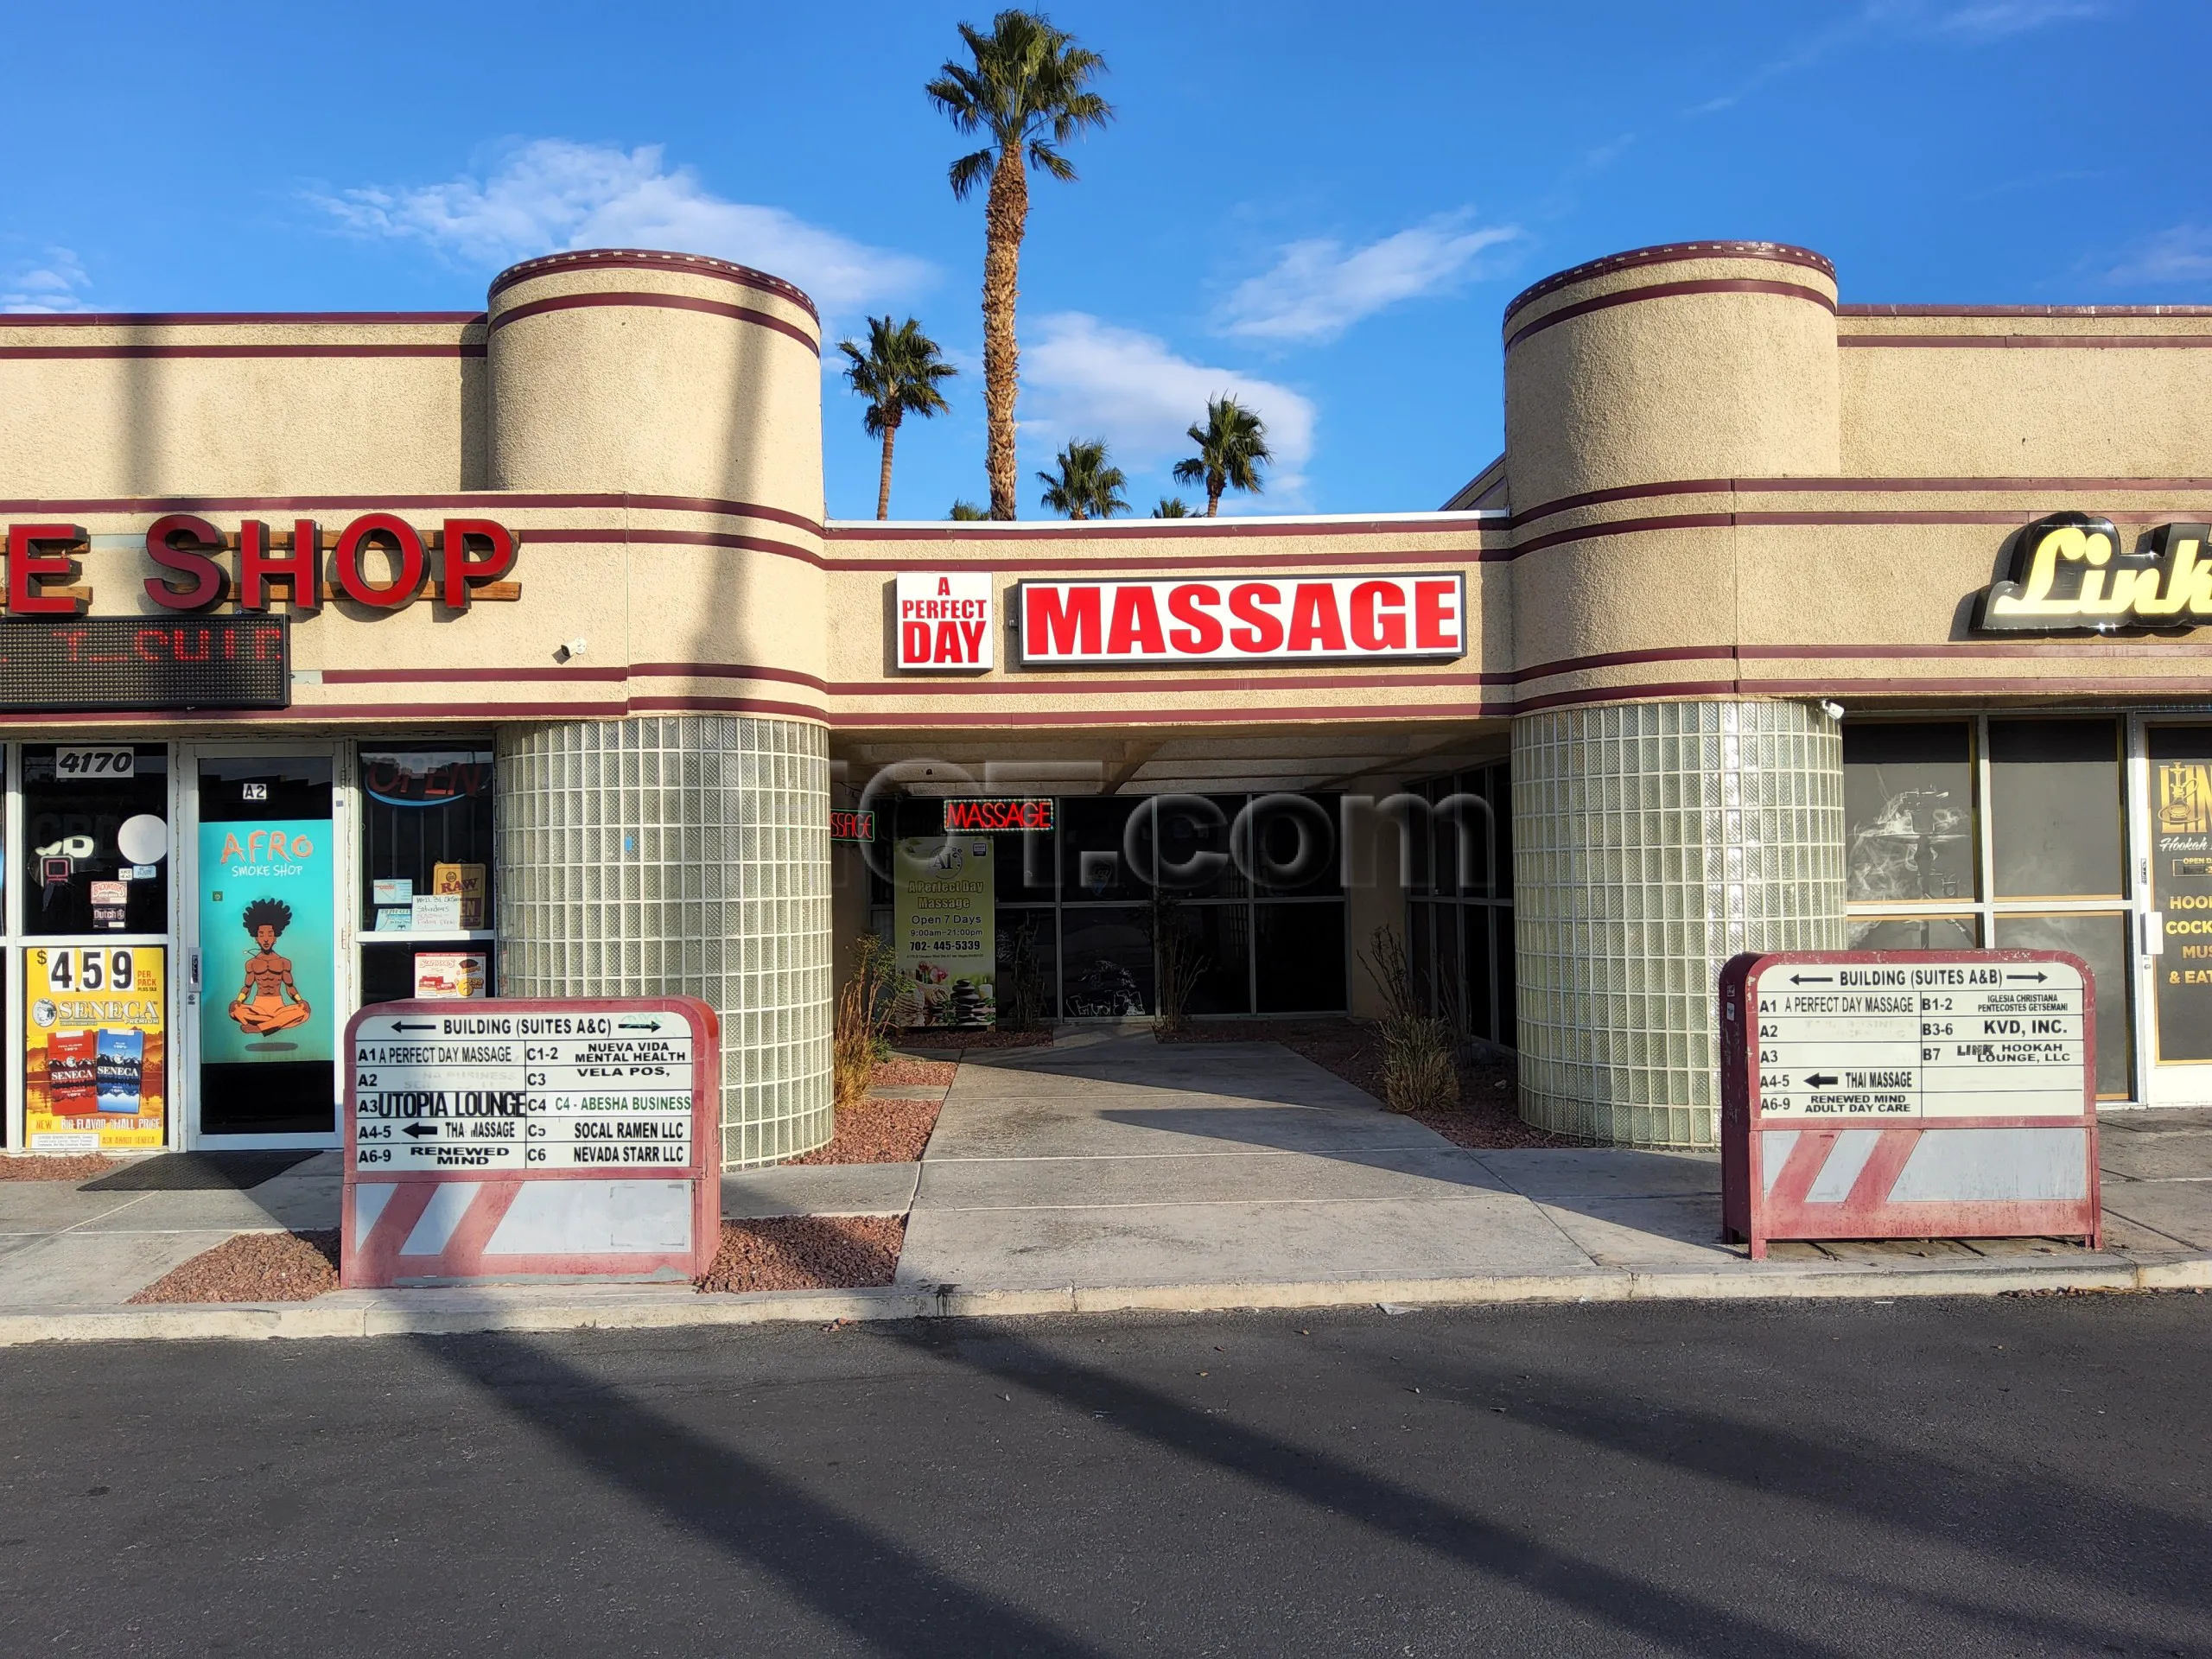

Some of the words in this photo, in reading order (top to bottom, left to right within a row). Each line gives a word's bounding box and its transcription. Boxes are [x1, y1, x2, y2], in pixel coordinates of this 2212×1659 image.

[143, 513, 518, 611] SHOP
[1993, 527, 2212, 614] Link
[936, 576, 950, 597] A
[902, 599, 987, 620] PERFECT
[1025, 580, 1459, 656] MASSAGE
[903, 620, 987, 664] DAY
[59, 752, 133, 773] 4170
[245, 784, 265, 798] A2
[945, 802, 1052, 829] MASSAGE
[830, 812, 873, 839] SSAGE
[221, 830, 315, 865] AFRO
[2159, 836, 2209, 852] Hookah
[231, 865, 270, 877] SMOKE
[273, 863, 303, 876] SHOP
[441, 877, 479, 893] RAW
[908, 881, 917, 893] A
[918, 880, 962, 893] Perfect
[962, 880, 984, 894] Day
[918, 897, 971, 910] Massage
[93, 909, 117, 918] Dutch
[912, 915, 941, 925] Open
[944, 915, 950, 924] 7
[953, 915, 982, 925] Days
[933, 940, 981, 950] 445-5339
[1840, 970, 1906, 986] BUILDING
[1910, 969, 1964, 989] (SUITES
[1968, 969, 2002, 988] A&B)
[2169, 970, 2181, 984] &
[1784, 996, 1792, 1013] A
[1795, 996, 1839, 1013] PERFECT
[1842, 996, 1862, 1013] DAY
[1865, 996, 1914, 1013] MASSAGE
[1922, 998, 1953, 1011] B1-2
[1987, 995, 2015, 1003] IGLESIA
[2016, 994, 2058, 1002] CHRISTIANA
[59, 1000, 160, 1020] SENECA
[1759, 1000, 1777, 1013] A1
[1978, 1003, 2027, 1012] PENTECOSTES
[2028, 1002, 2069, 1011] GETSEMANI
[443, 1019, 512, 1034] BUILDING
[516, 1018, 572, 1038] (SUITES
[576, 1018, 612, 1038] A&C)
[1759, 1025, 1778, 1038] A2
[1923, 1023, 1954, 1036] B3-6
[1984, 1020, 2026, 1037] KVD,
[2031, 1020, 2068, 1034] INC.
[526, 1047, 559, 1060] C1-2
[588, 1042, 634, 1052] NUEVA
[638, 1041, 670, 1052] VIDA
[2002, 1044, 2063, 1052] HOOKAH
[358, 1048, 376, 1061] A1
[378, 1047, 387, 1064] A
[389, 1047, 435, 1064] PERFECT
[438, 1046, 460, 1063] DAY
[461, 1046, 512, 1062] MASSAGE
[575, 1052, 629, 1063] MENTAL
[633, 1052, 686, 1062] HEALTH
[1760, 1050, 1778, 1063] A3
[1923, 1048, 1941, 1061] B7
[1977, 1053, 2040, 1064] LOUNGE,
[2044, 1053, 2071, 1062] LLC
[52, 1070, 93, 1080] SENECA
[97, 1065, 138, 1077] SENECA
[577, 1068, 623, 1077] VELA
[629, 1066, 671, 1077] POS,
[358, 1073, 378, 1087] A2
[527, 1072, 546, 1086] C3
[1760, 1074, 1790, 1088] A4-5
[1846, 1071, 1866, 1089] THAI
[1869, 1071, 1912, 1088] MASSAGE
[358, 1099, 378, 1113] A3
[378, 1091, 448, 1117] UTOPIA
[454, 1091, 526, 1117] LOUNGE
[528, 1098, 547, 1111] C4
[555, 1096, 570, 1111] C4
[581, 1096, 629, 1111] ABESHA
[632, 1096, 691, 1110] BUSINESS
[1761, 1097, 1791, 1110] A6-9
[1810, 1095, 1871, 1104] RENEWED
[1874, 1095, 1906, 1103] MIND
[1805, 1104, 1845, 1113] ADULT
[1849, 1103, 1874, 1113] DAY
[1878, 1103, 1911, 1113] CARE
[36, 1120, 53, 1129] NEW
[60, 1118, 73, 1130] BIG
[138, 1118, 161, 1129] PRICE
[445, 1122, 467, 1138] THA
[574, 1122, 613, 1138] SOCAL
[616, 1122, 658, 1138] RAMEN
[662, 1122, 683, 1138] LLC
[359, 1125, 391, 1139] A4-5
[359, 1149, 391, 1163] A6-9
[410, 1147, 510, 1156] RENEWED
[527, 1148, 546, 1161] C6
[574, 1147, 620, 1162] NEVADA
[622, 1147, 660, 1162] STARR
[663, 1146, 683, 1162] LLC
[436, 1156, 489, 1165] MIND
